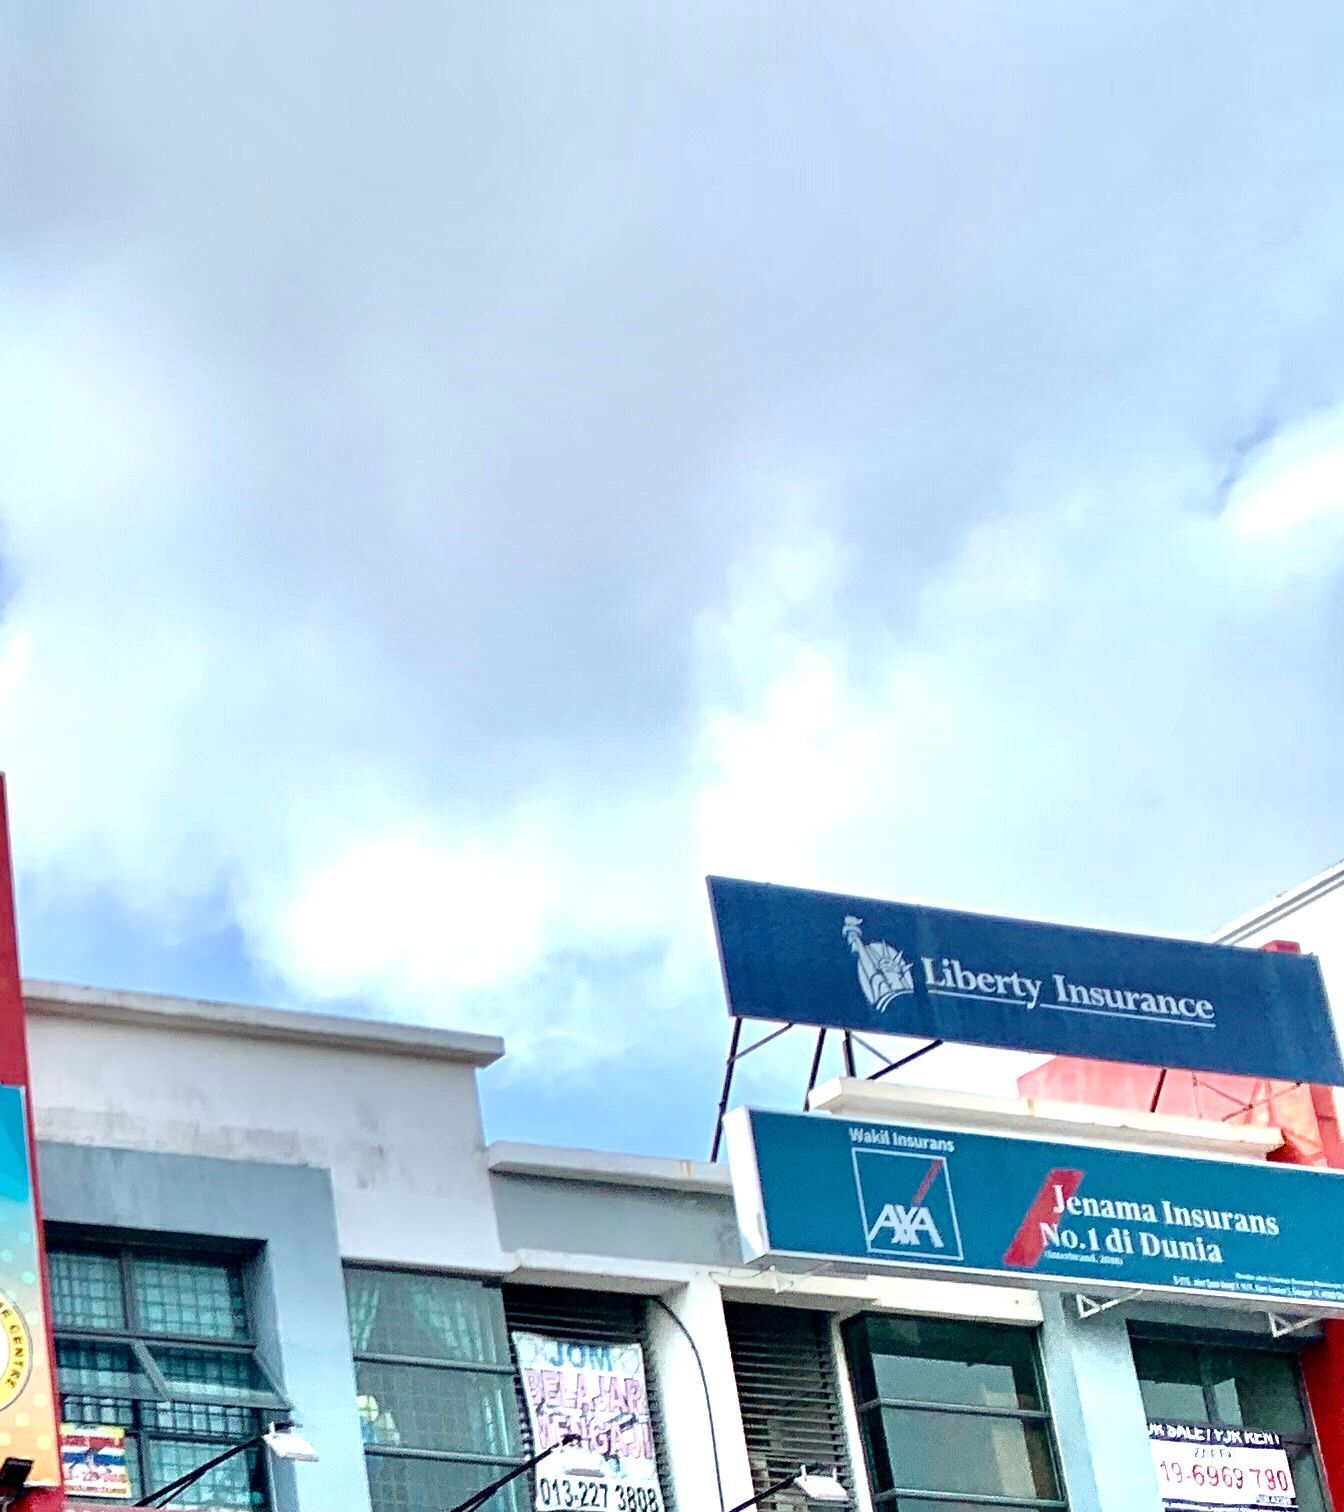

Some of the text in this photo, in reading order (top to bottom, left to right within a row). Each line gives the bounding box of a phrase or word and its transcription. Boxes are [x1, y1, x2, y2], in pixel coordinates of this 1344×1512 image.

[921, 957, 1215, 1021] Liberty Insurance
[849, 1127, 954, 1154] Wakil Insurans
[869, 1203, 944, 1249] AXA
[1052, 1184, 1280, 1237] Jenama Insurans
[1039, 1221, 1224, 1266] No.1 di Dunia
[540, 1478, 608, 1509] 013-227
